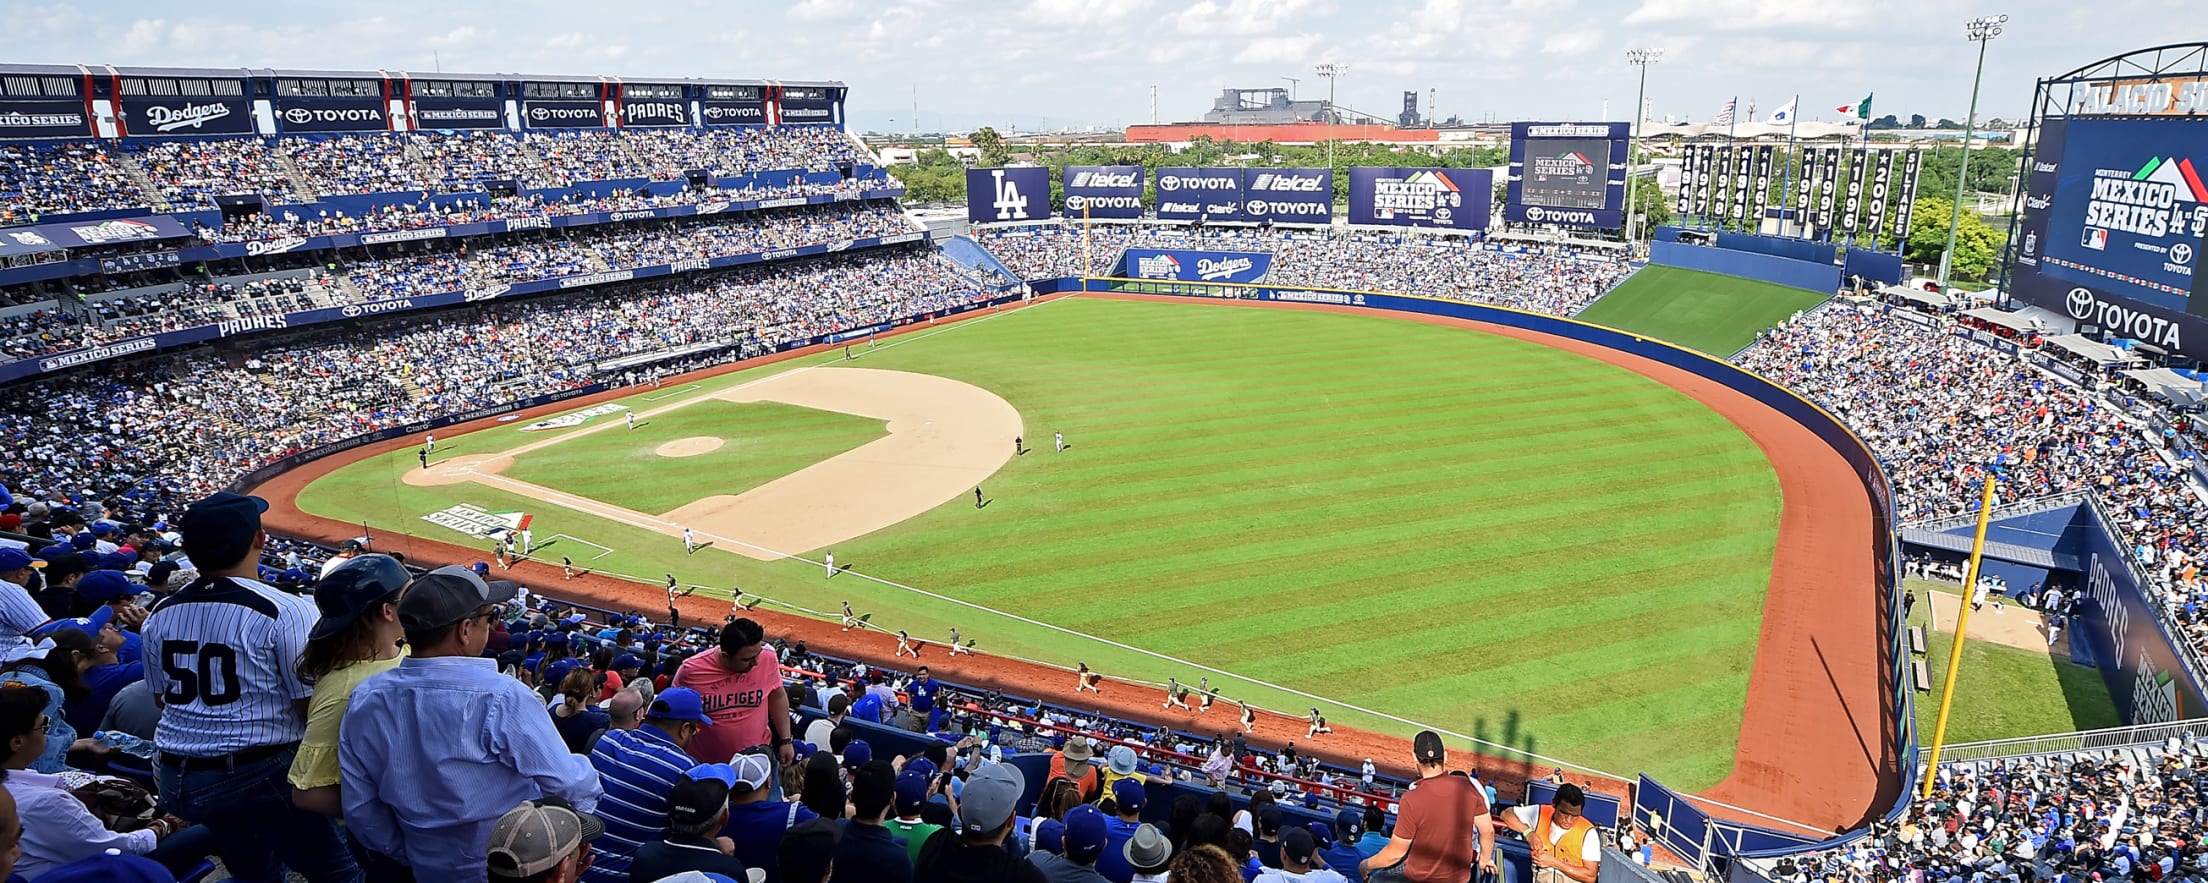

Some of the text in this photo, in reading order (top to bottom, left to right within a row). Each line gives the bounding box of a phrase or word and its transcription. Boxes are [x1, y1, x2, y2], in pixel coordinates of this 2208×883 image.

[2070, 82, 2172, 114] PALACIO
[32, 115, 81, 124] SERIES
[147, 102, 230, 132] Dodgers
[313, 108, 381, 122] TOYOTA
[432, 110, 497, 119] MEXICO SERIES
[550, 109, 598, 119] TOYOTA
[627, 103, 684, 123] PADRES
[723, 108, 761, 117] TOYOTA
[1534, 166, 1575, 175] SERIES
[1535, 159, 1575, 167] MEXICO
[1088, 172, 1137, 188] telcel
[1181, 178, 1236, 190] TOYOTA
[1270, 174, 1324, 191] telcel
[1678, 157, 1691, 211] 1943
[1696, 160, 1708, 212] 1947
[1715, 161, 1728, 214] 1948
[991, 170, 1027, 219] LA
[1375, 183, 1436, 196] MEXICO
[1733, 160, 1748, 218] 1949
[1753, 163, 1767, 218] 1962
[1798, 164, 1810, 222] 1991
[1818, 165, 1833, 225] 1995
[1844, 166, 1860, 227] 1996
[1895, 153, 1916, 234] SULTANES
[2090, 177, 2175, 209] MEXICO
[1088, 197, 1141, 208] TOYOTA
[1374, 194, 1435, 209] SERIES
[1868, 167, 1887, 229] 2007
[2027, 194, 2051, 209] Claro
[622, 210, 655, 219] TOYOTA
[1207, 202, 1237, 214] Claro
[1269, 203, 1327, 215] TOYOTA
[507, 216, 551, 231] PADRES
[1545, 211, 1595, 223] TOYOTA
[2085, 200, 2170, 237] SERIES
[375, 228, 446, 242] MEXICO SERIES
[246, 235, 307, 255] Dodgers
[772, 250, 798, 259] TOYOTA
[1197, 256, 1253, 280] Dodgers
[2163, 263, 2192, 276] TOYOTA
[362, 299, 412, 314] TOYOTA
[218, 314, 287, 337] PADRES
[2096, 300, 2181, 350] TOYOTA
[57, 338, 156, 367] MEXICO SERIES
[560, 389, 583, 398] TOYOTA
[464, 409, 491, 420] MEXICO
[406, 422, 431, 434] Claro
[2087, 553, 2128, 670] PADRES
[162, 640, 241, 706] 50
[2137, 653, 2173, 721] MEXICO
[703, 689, 764, 711] HILFIGER
